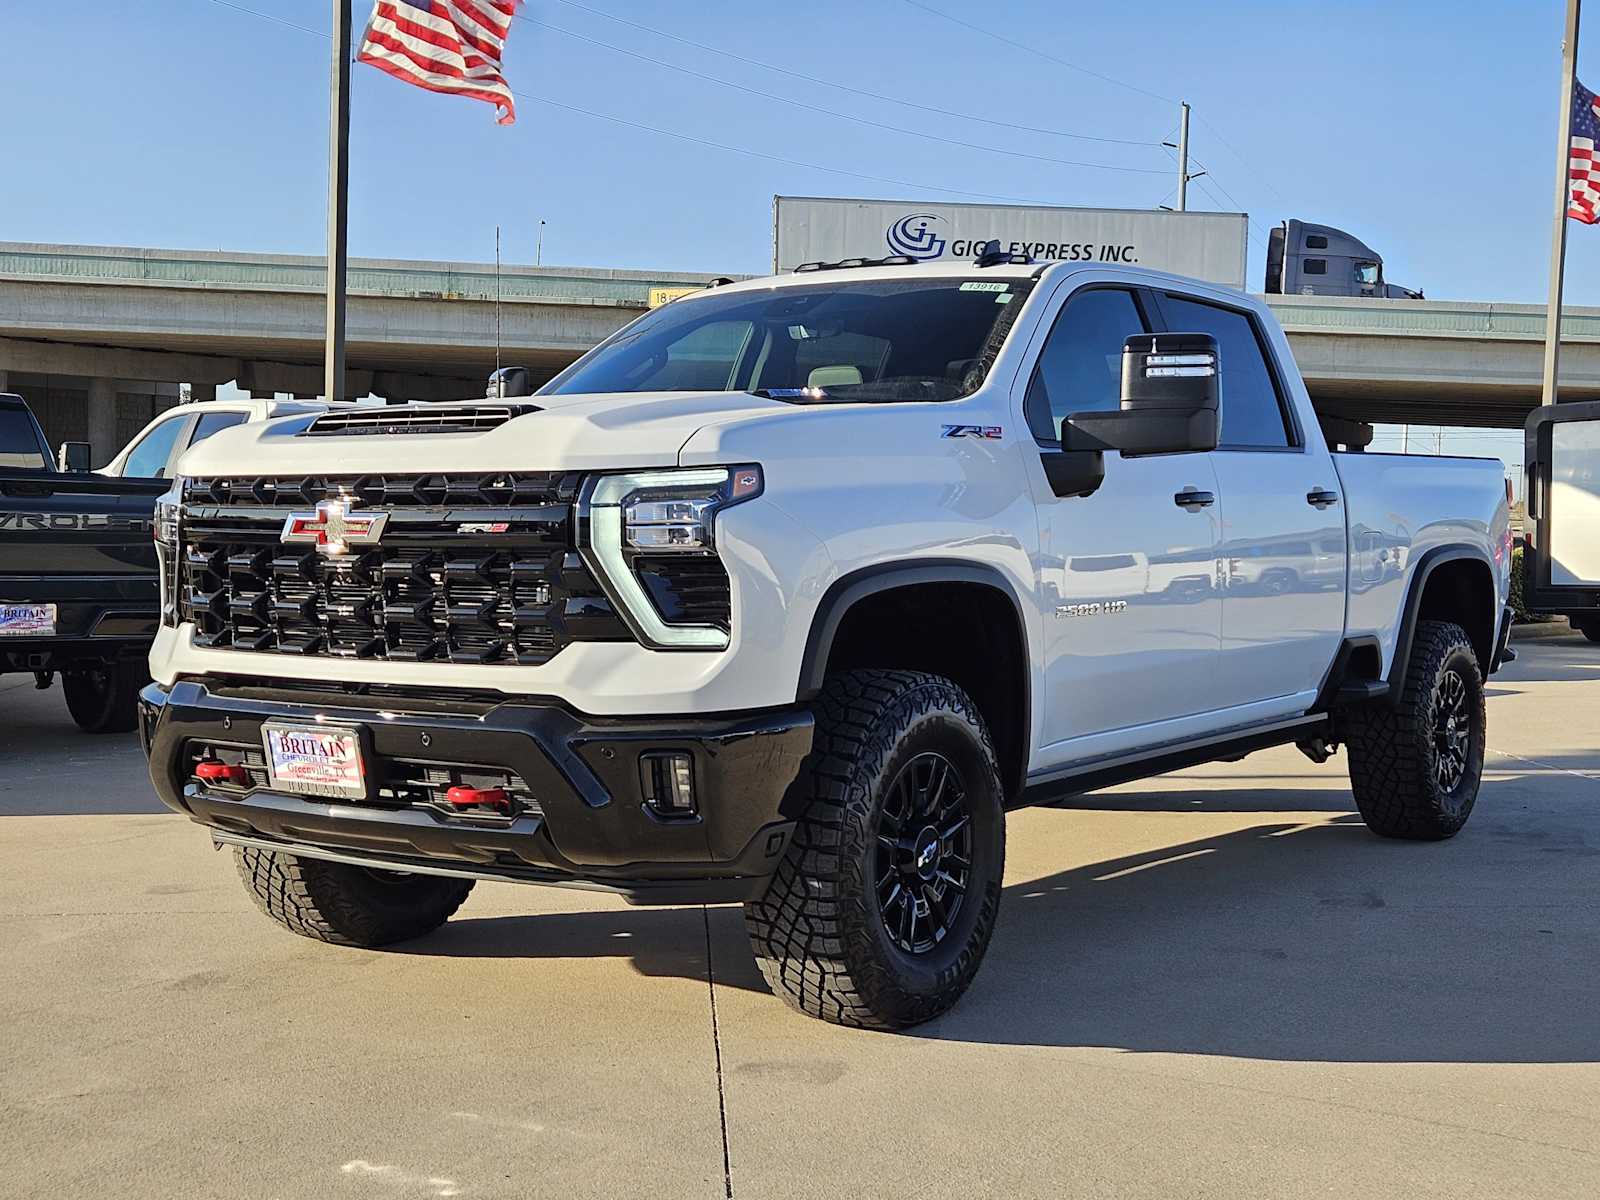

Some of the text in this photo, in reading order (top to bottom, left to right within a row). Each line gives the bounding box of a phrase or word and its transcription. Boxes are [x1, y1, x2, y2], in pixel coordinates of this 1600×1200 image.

[1008, 241, 1093, 261] EXPRESS
[1099, 245, 1138, 262] INC.
[656, 292, 667, 304] 18
[940, 424, 1002, 439] ZR2
[4, 609, 46, 618] BRITAIN
[279, 735, 347, 759] BRITAIN
